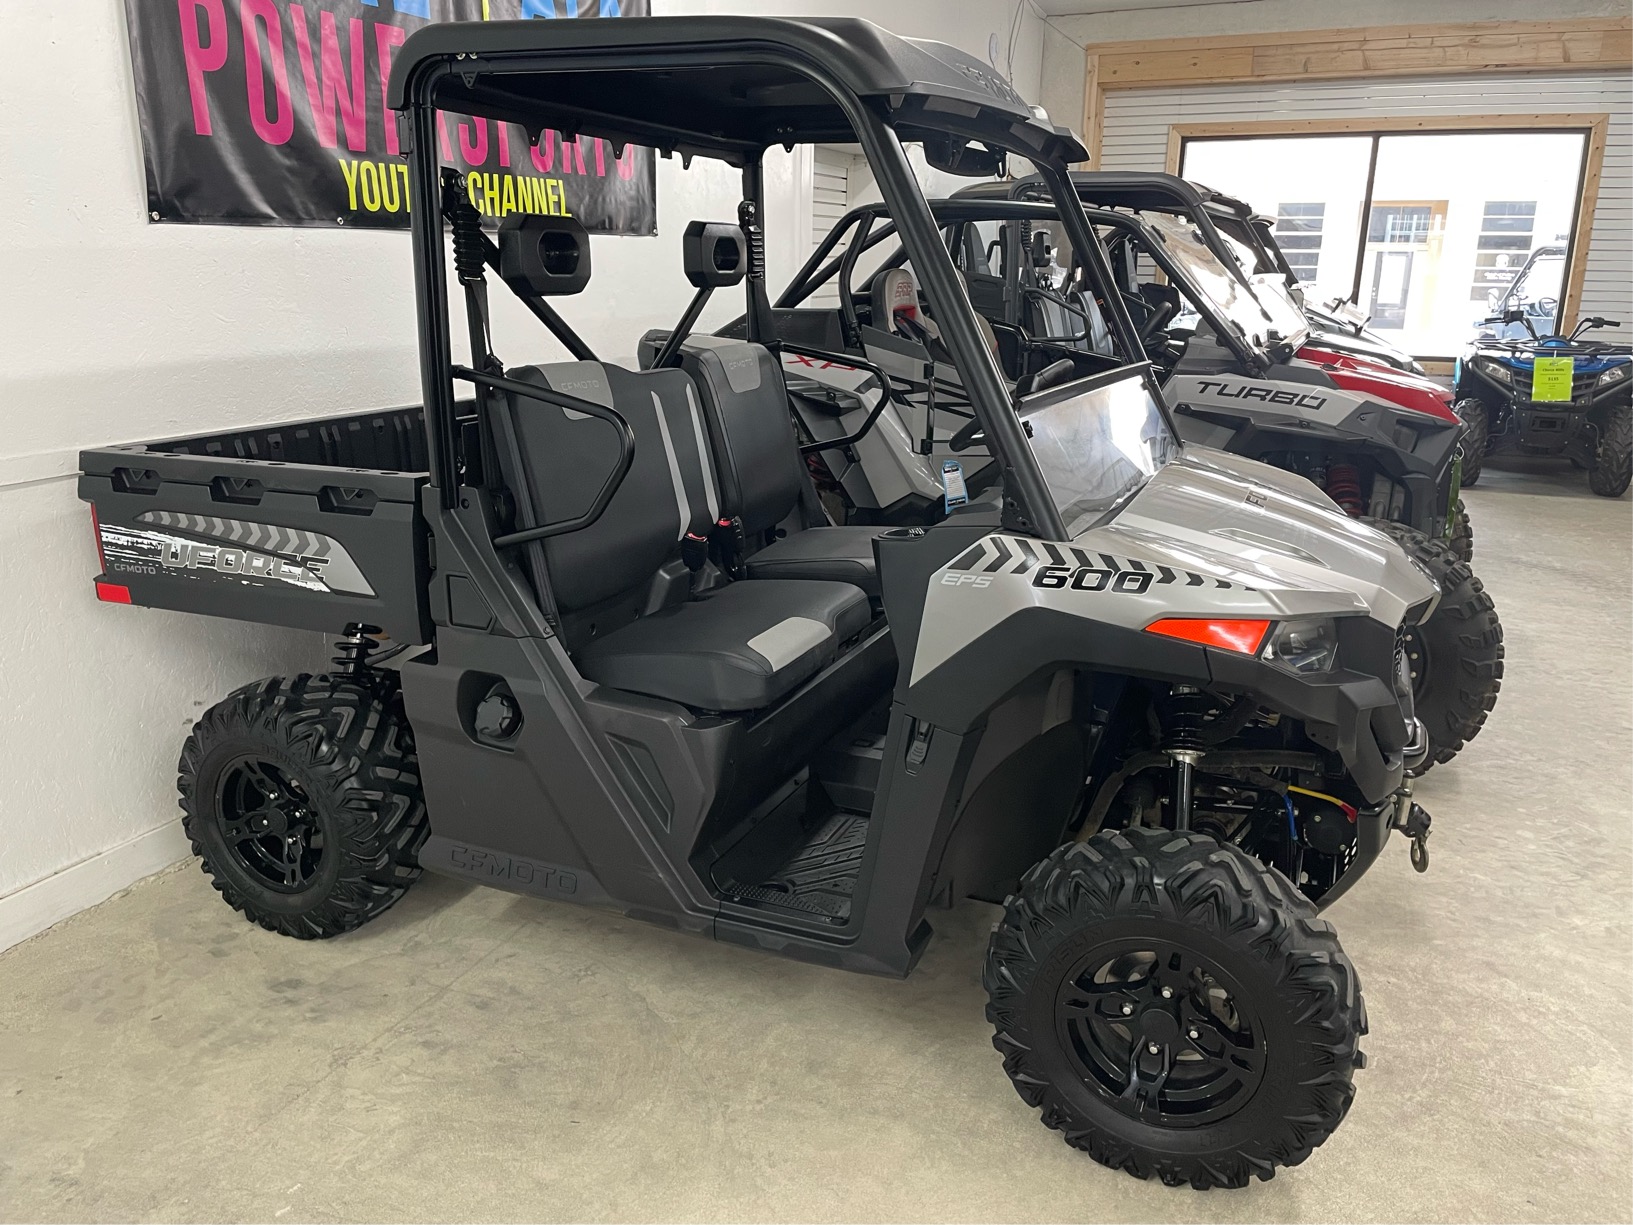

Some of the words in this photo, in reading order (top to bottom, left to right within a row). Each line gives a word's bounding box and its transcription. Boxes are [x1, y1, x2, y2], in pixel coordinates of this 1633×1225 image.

[338, 158, 446, 213] YOUT
[467, 171, 572, 217] CHANNEL
[560, 380, 600, 392] CFMOTO
[1197, 381, 1328, 411] TURBO
[114, 562, 156, 575] CFMOTO
[160, 541, 331, 582] UFORCE
[940, 572, 995, 589] EPS
[1031, 565, 1155, 595] 600
[450, 844, 578, 895] CFMOTO
